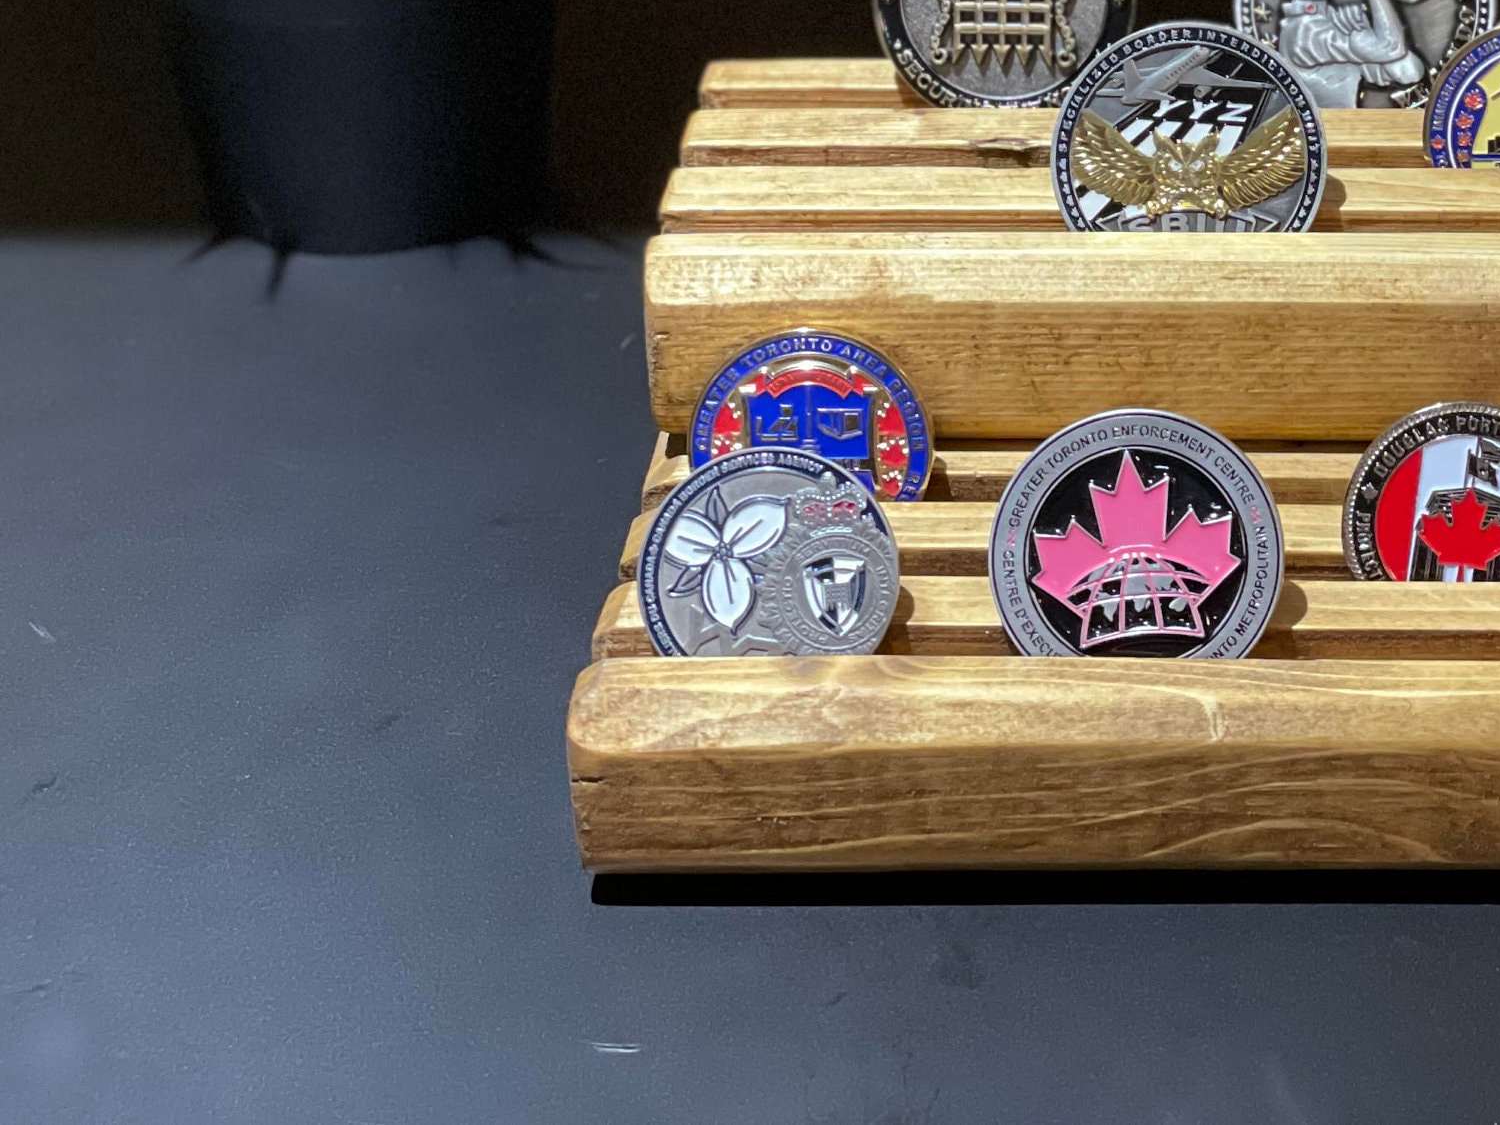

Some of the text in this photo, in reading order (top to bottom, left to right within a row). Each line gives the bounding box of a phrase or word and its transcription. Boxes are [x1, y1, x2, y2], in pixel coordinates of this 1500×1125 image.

[898, 49, 970, 107] SECUR
[1058, 54, 1118, 153] SPECIALIZED
[1123, 29, 1191, 59] BORDER
[1199, 29, 1306, 108] INTERDICTION
[1153, 99, 1253, 122] YYZ
[1432, 52, 1478, 131] IMMIGRATION
[696, 337, 924, 451] GREATER TORONTO AREA REGION
[1009, 424, 1256, 528] GREATER TORONTO ENFORCEMENT CENTRE
[1373, 418, 1450, 478] DOUGLAS
[652, 498, 682, 544] CANADA
[677, 466, 721, 502] BORDER
[721, 452, 774, 473] SERVICES
[778, 453, 824, 474] AGENCY
[644, 556, 656, 603] CANADA
[1003, 550, 1022, 607] CENTRE
[1356, 510, 1384, 580] PROTECT
[1209, 526, 1269, 659] NTO METROPOLITAIN
